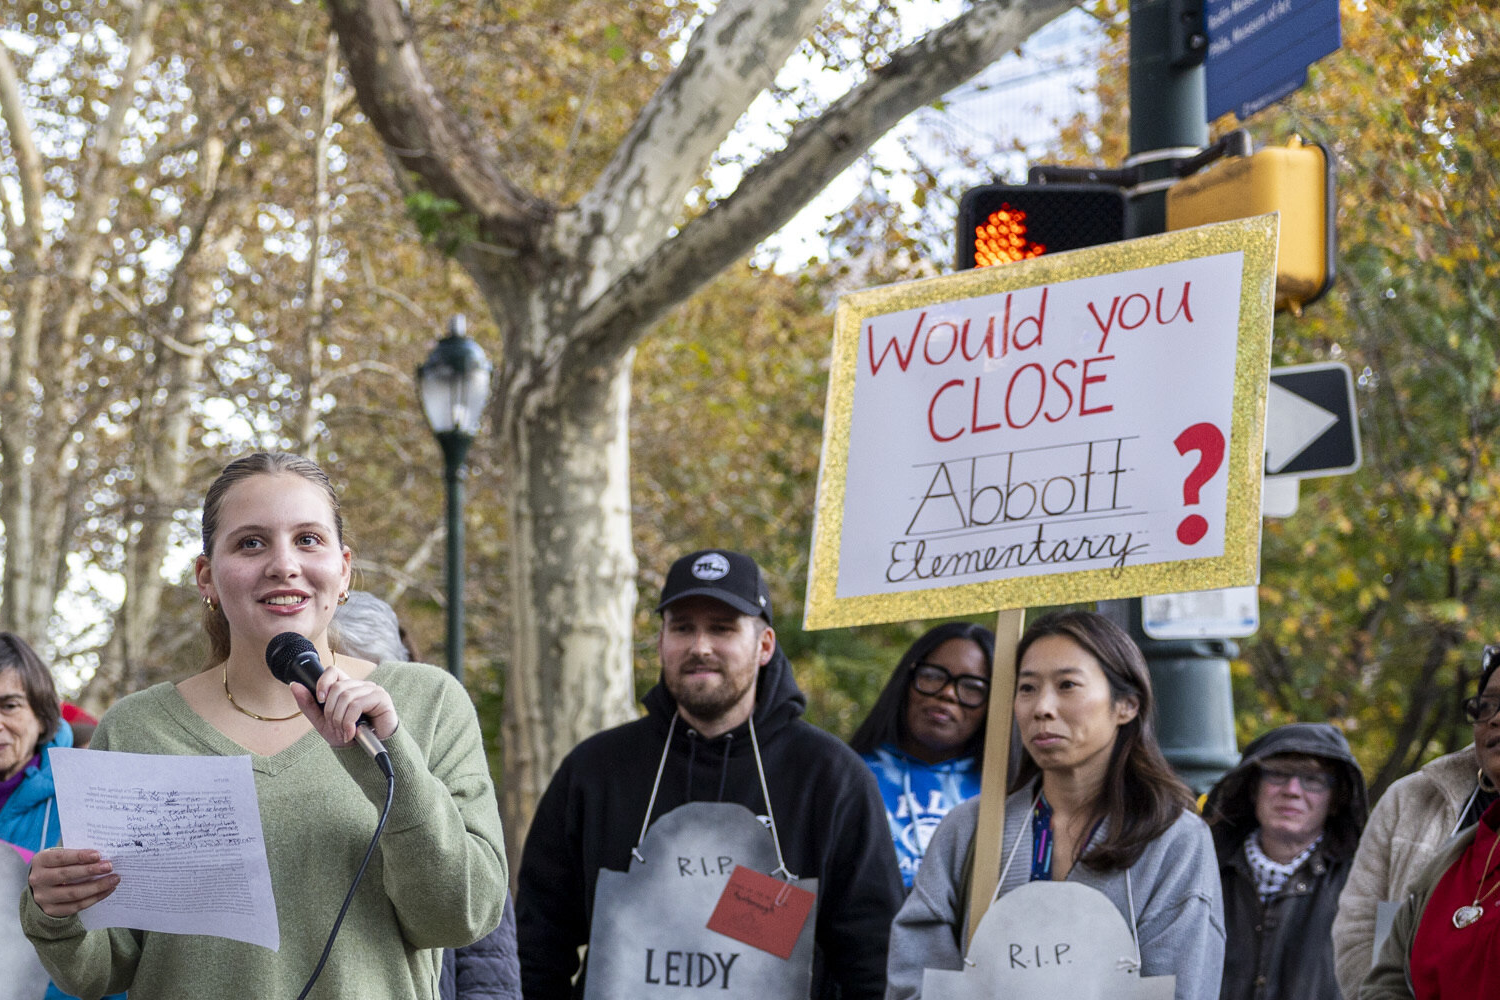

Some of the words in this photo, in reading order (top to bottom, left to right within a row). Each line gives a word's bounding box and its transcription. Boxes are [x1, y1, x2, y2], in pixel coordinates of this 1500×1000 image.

[867, 287, 1049, 376] Would
[1086, 281, 1194, 354] you
[927, 355, 1115, 443] CLOSE
[904, 438, 1128, 536] Abbott
[1173, 422, 1226, 546] ?
[885, 523, 1150, 581] Elementary
[644, 948, 741, 990] LEIDY
[1009, 943, 1073, 969] R.I.P.
